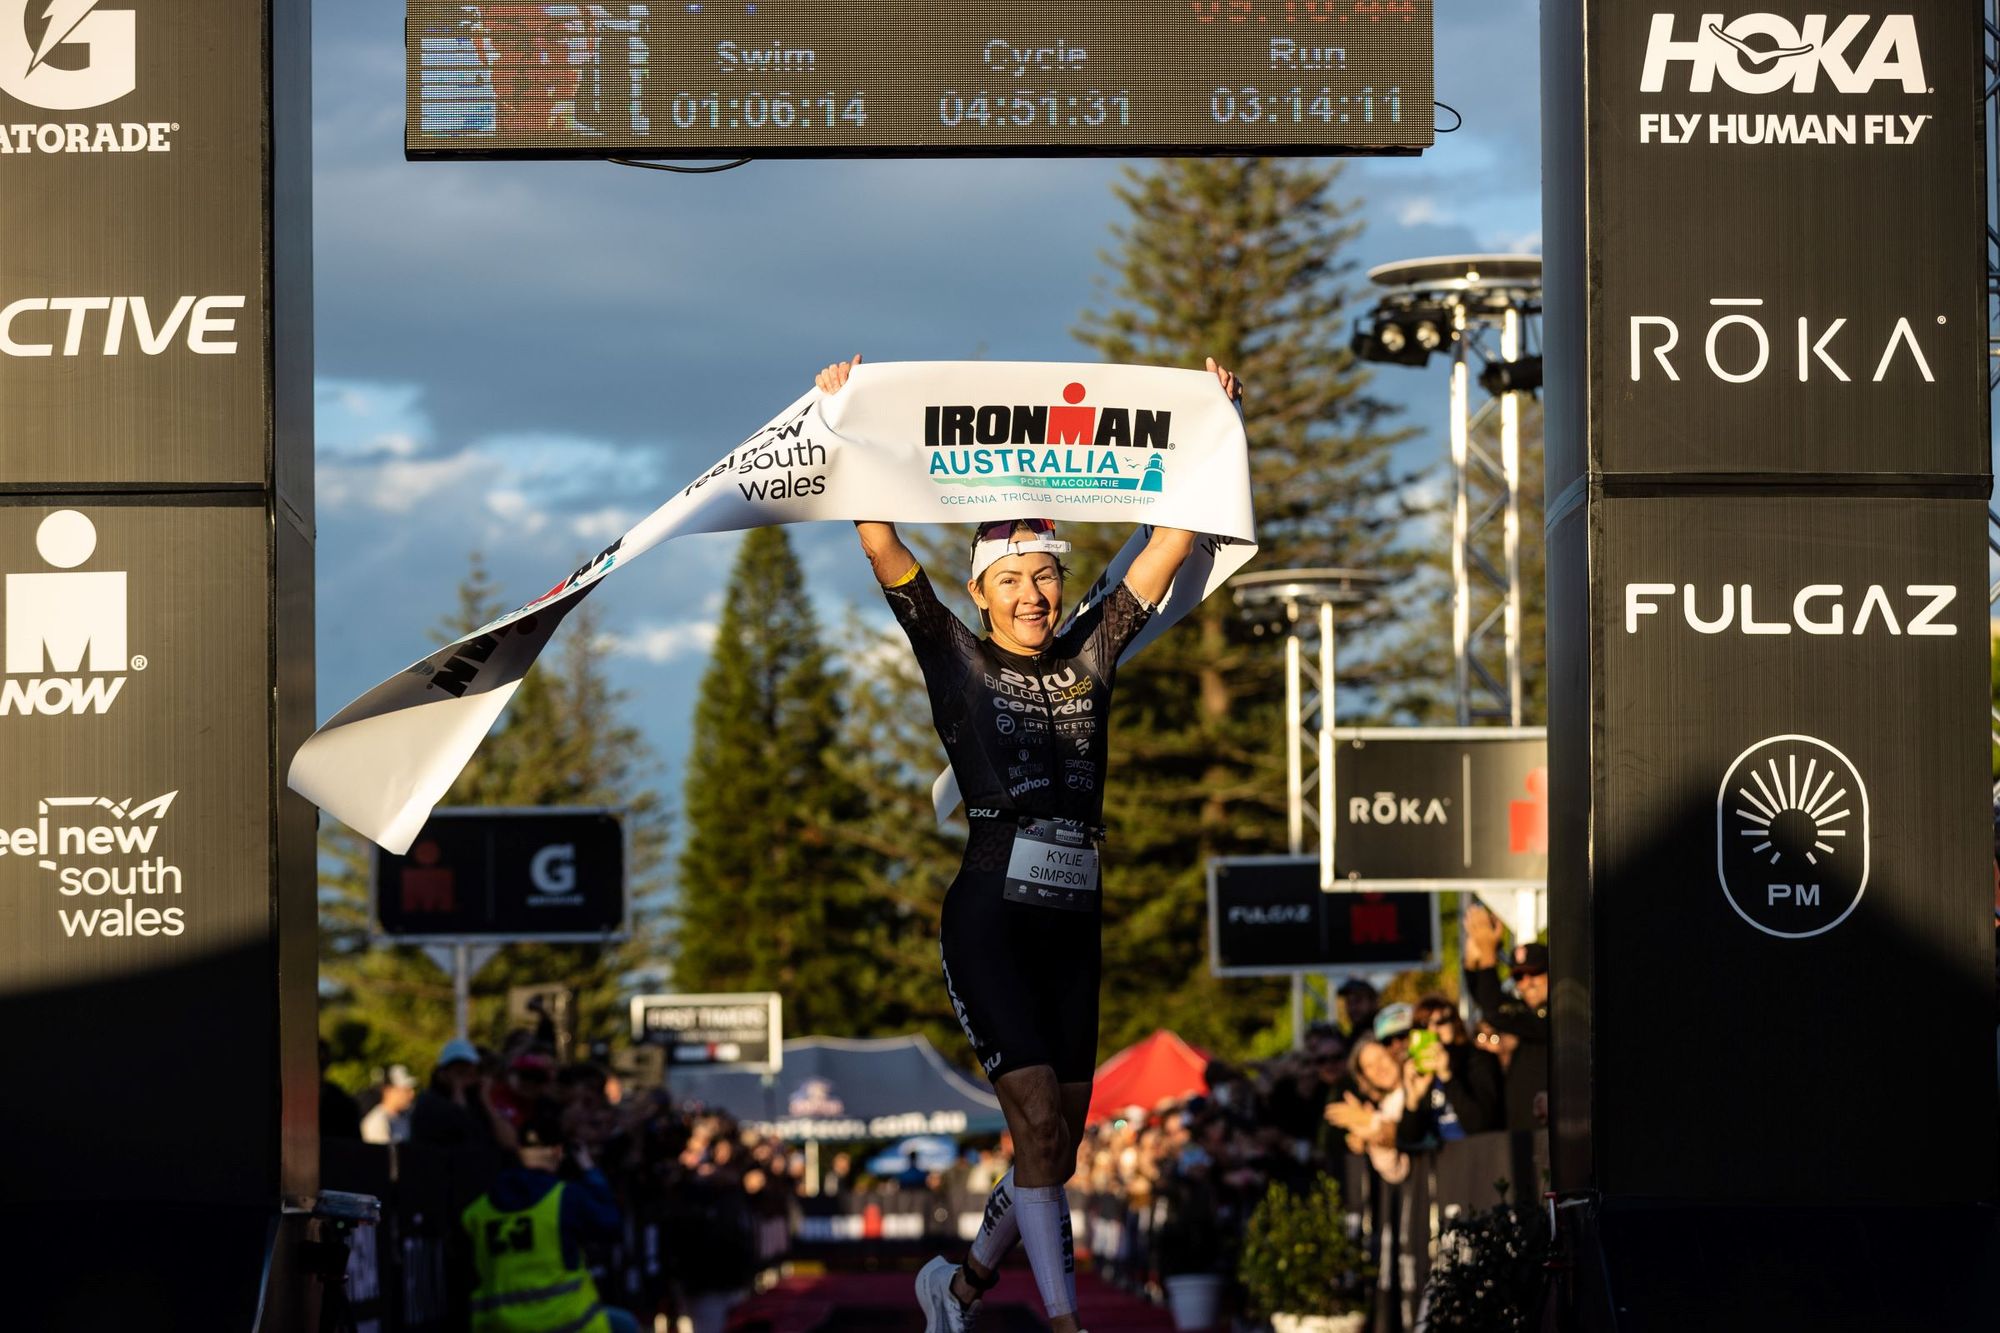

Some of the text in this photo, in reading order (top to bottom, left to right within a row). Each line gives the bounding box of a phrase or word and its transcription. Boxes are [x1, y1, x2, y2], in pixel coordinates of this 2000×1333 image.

[715, 39, 816, 72] Swim
[1270, 37, 1346, 69] Run
[1640, 13, 1927, 94] HOKA
[671, 86, 1401, 128] 01:06:14 04:51:31 03:14:11
[1639, 113, 1926, 145] FLY HUMAN FLY
[925, 404, 1172, 450] IRONMAN
[738, 438, 827, 475] south
[929, 448, 1120, 475] AUSTRALIA
[738, 470, 827, 502] wales
[940, 492, 1156, 506] OCEANIA TRICLUB CHAMPIONSHIP
[1020, 477, 1119, 489] PORT MACQUARIE
[1625, 583, 1958, 636] FULGAZ
[1001, 667, 1077, 692] 2XU
[0, 676, 127, 716] NOW
[1009, 778, 1051, 798] wahoo
[969, 808, 1001, 818] 2XU
[59, 823, 159, 855] new
[1046, 849, 1084, 868] KYLIE
[59, 857, 182, 897] south
[1029, 865, 1088, 887] SIMPSON
[1767, 884, 1820, 906] PM
[58, 899, 185, 938] wales
[984, 1051, 1002, 1075] XU
